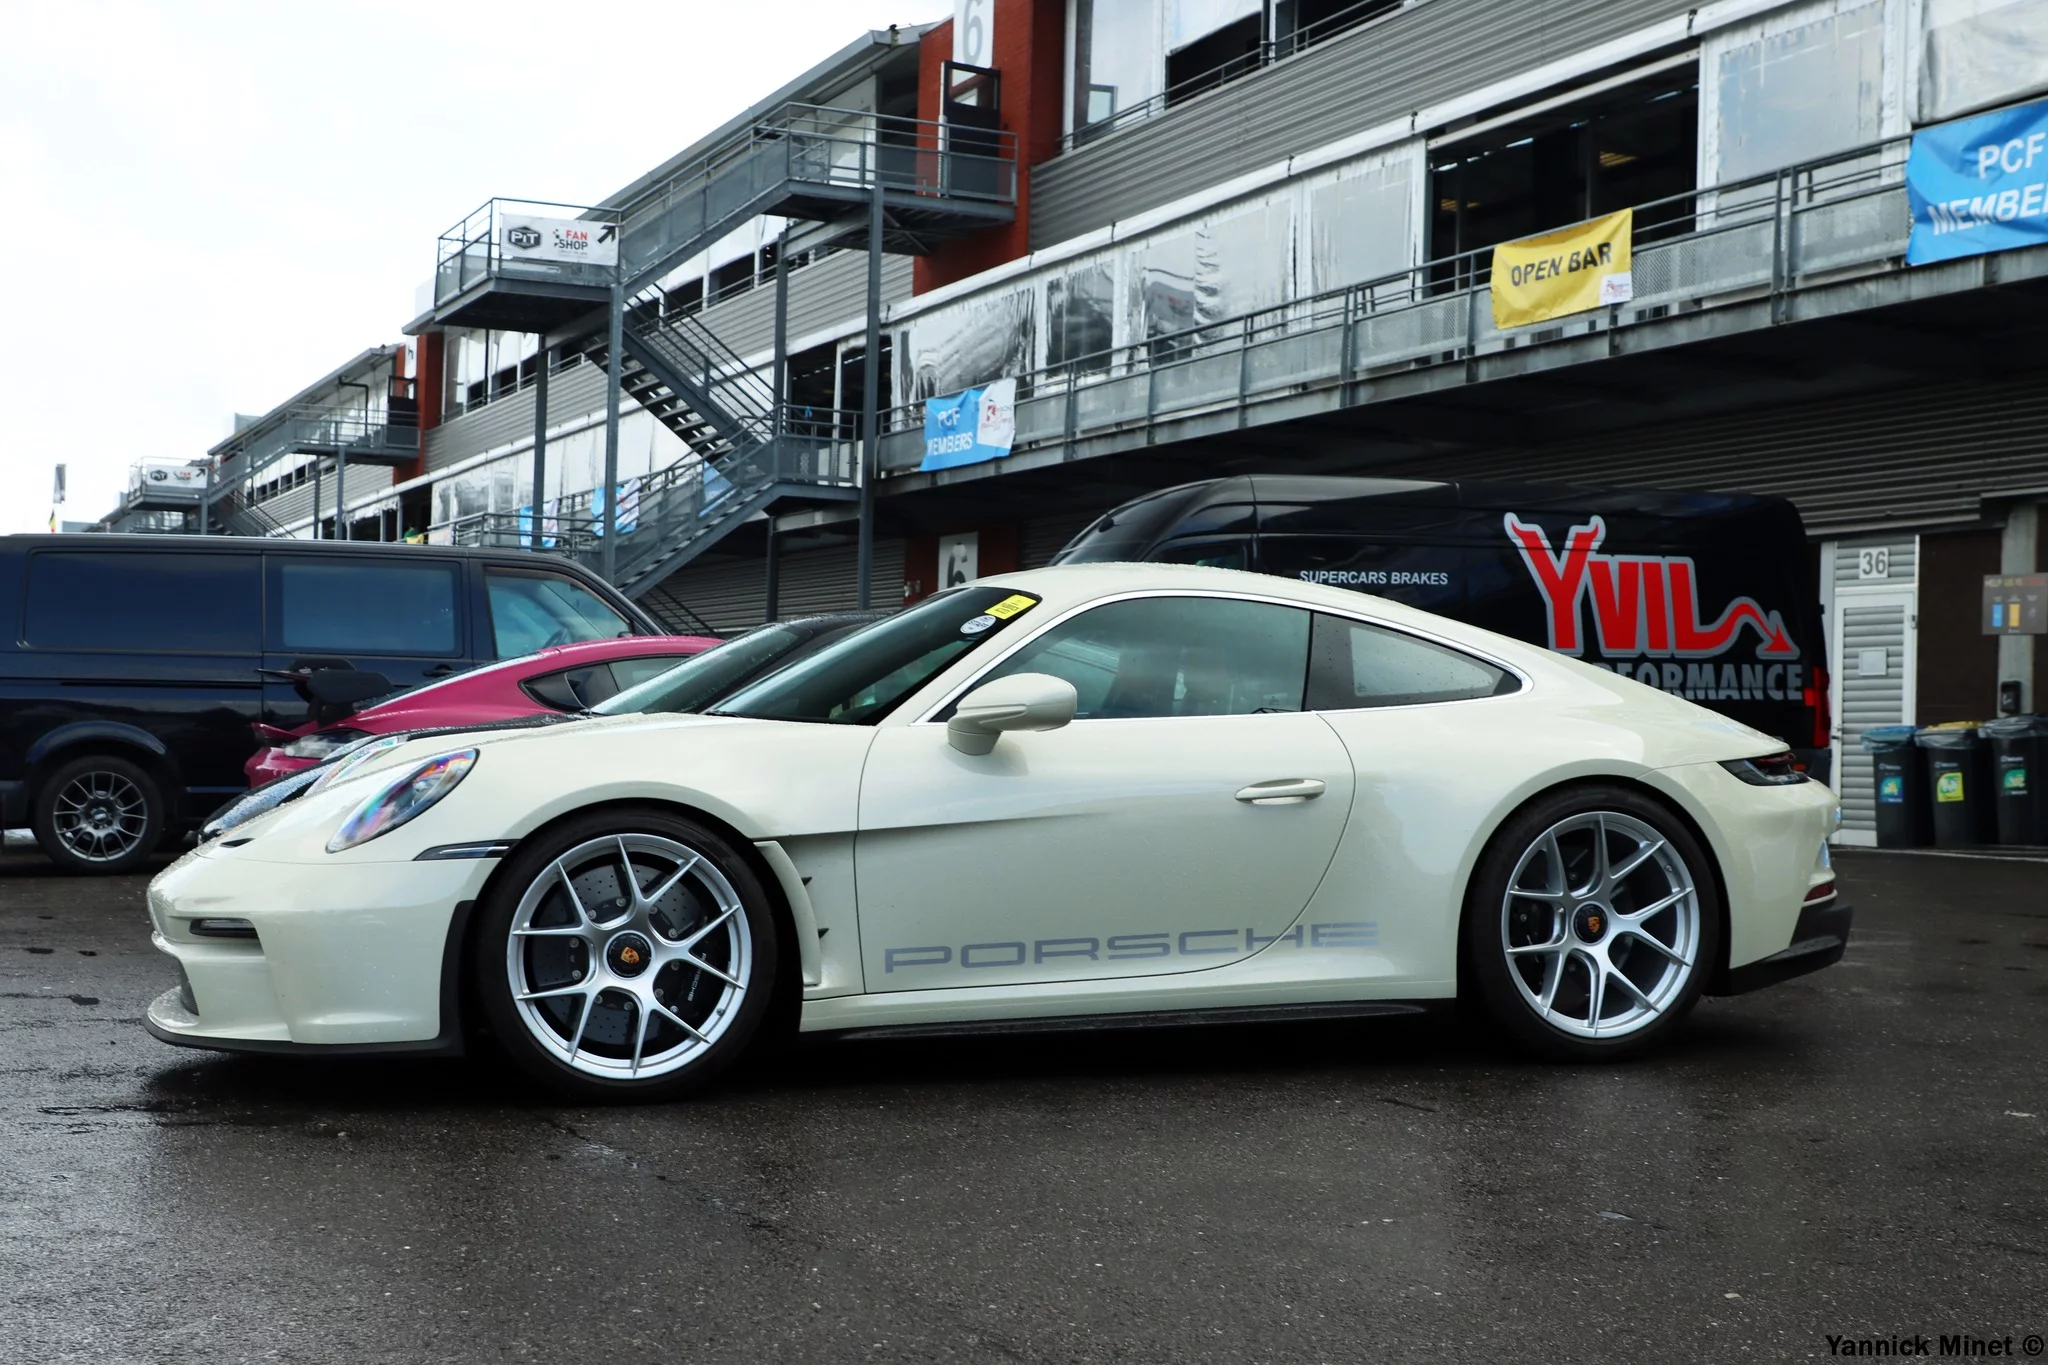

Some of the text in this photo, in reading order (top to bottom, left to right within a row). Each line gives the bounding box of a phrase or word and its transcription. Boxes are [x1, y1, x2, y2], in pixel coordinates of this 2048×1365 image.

[1979, 132, 2046, 180] PCF
[1927, 183, 2048, 235] MEMBE
[559, 239, 588, 250] SHOP
[565, 230, 588, 240] FAN
[1511, 242, 1612, 287] OPEN BAR
[937, 407, 960, 428] PCF
[1300, 571, 1448, 585] SUPERCARS BRAKES
[1862, 551, 1886, 575] 36
[1503, 511, 1800, 659] YVIL
[1592, 662, 1803, 701] ORMANCE
[885, 921, 1378, 973] PORSCHE
